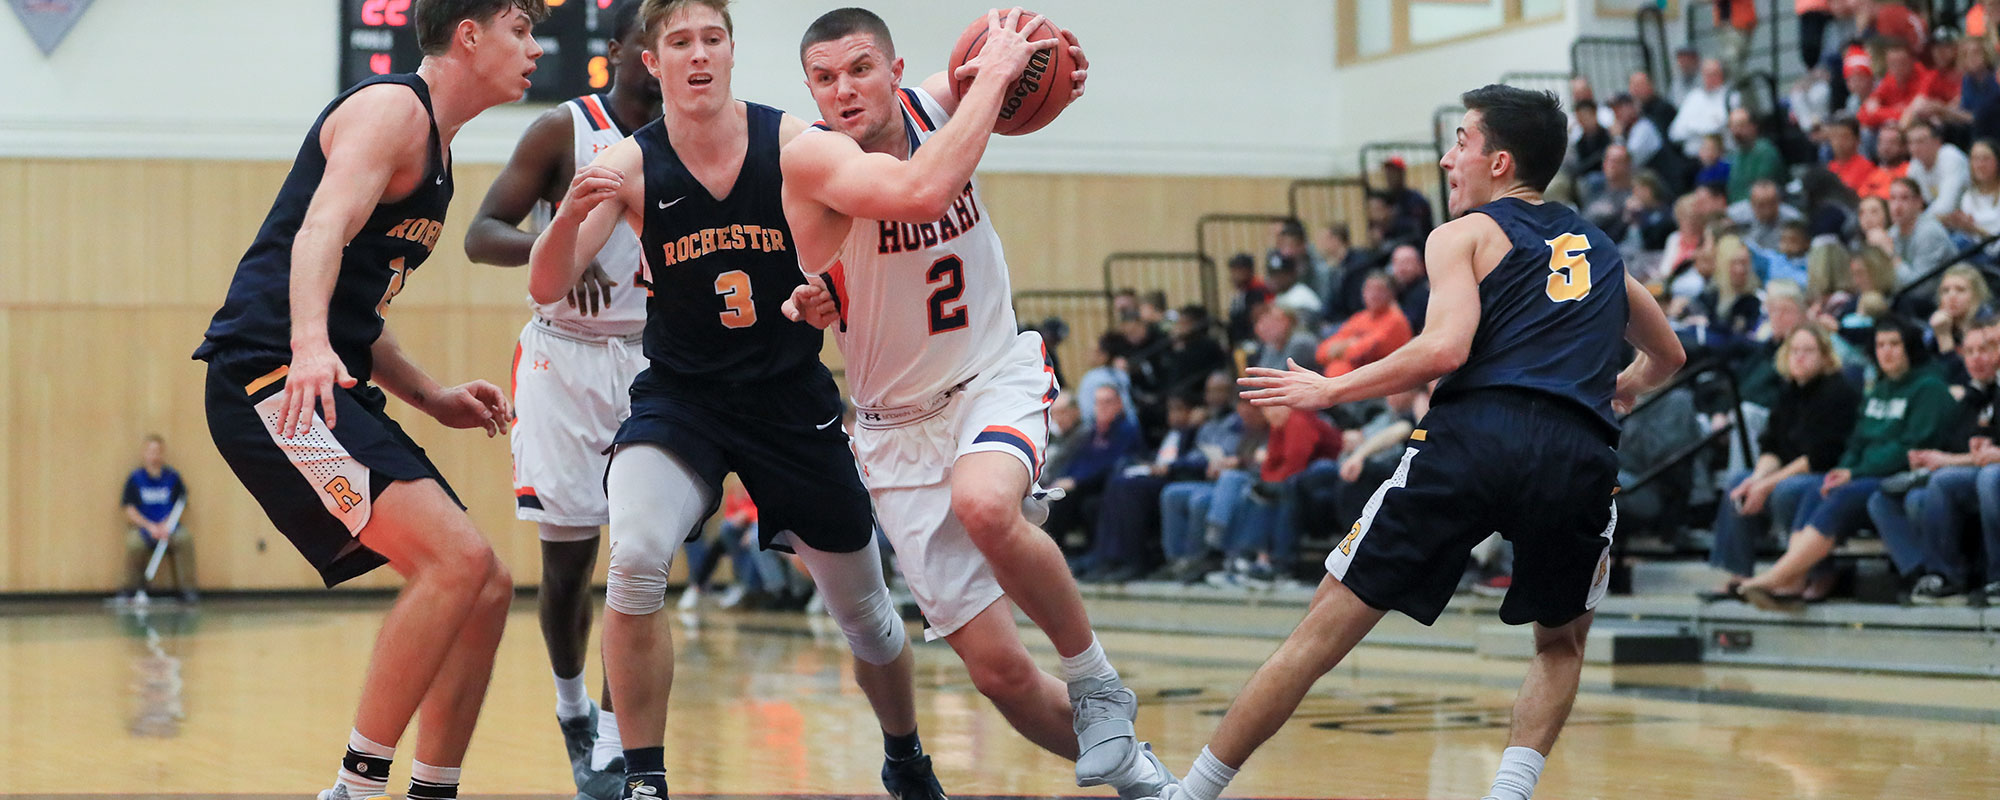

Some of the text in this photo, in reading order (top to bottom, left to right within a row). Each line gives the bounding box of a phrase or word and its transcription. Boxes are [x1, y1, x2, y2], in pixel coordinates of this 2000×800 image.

[663, 224, 786, 266] ROCHESTER
[1544, 232, 1592, 302] 5
[714, 269, 757, 329] 3
[926, 253, 969, 336] 2
[323, 475, 363, 513] R
